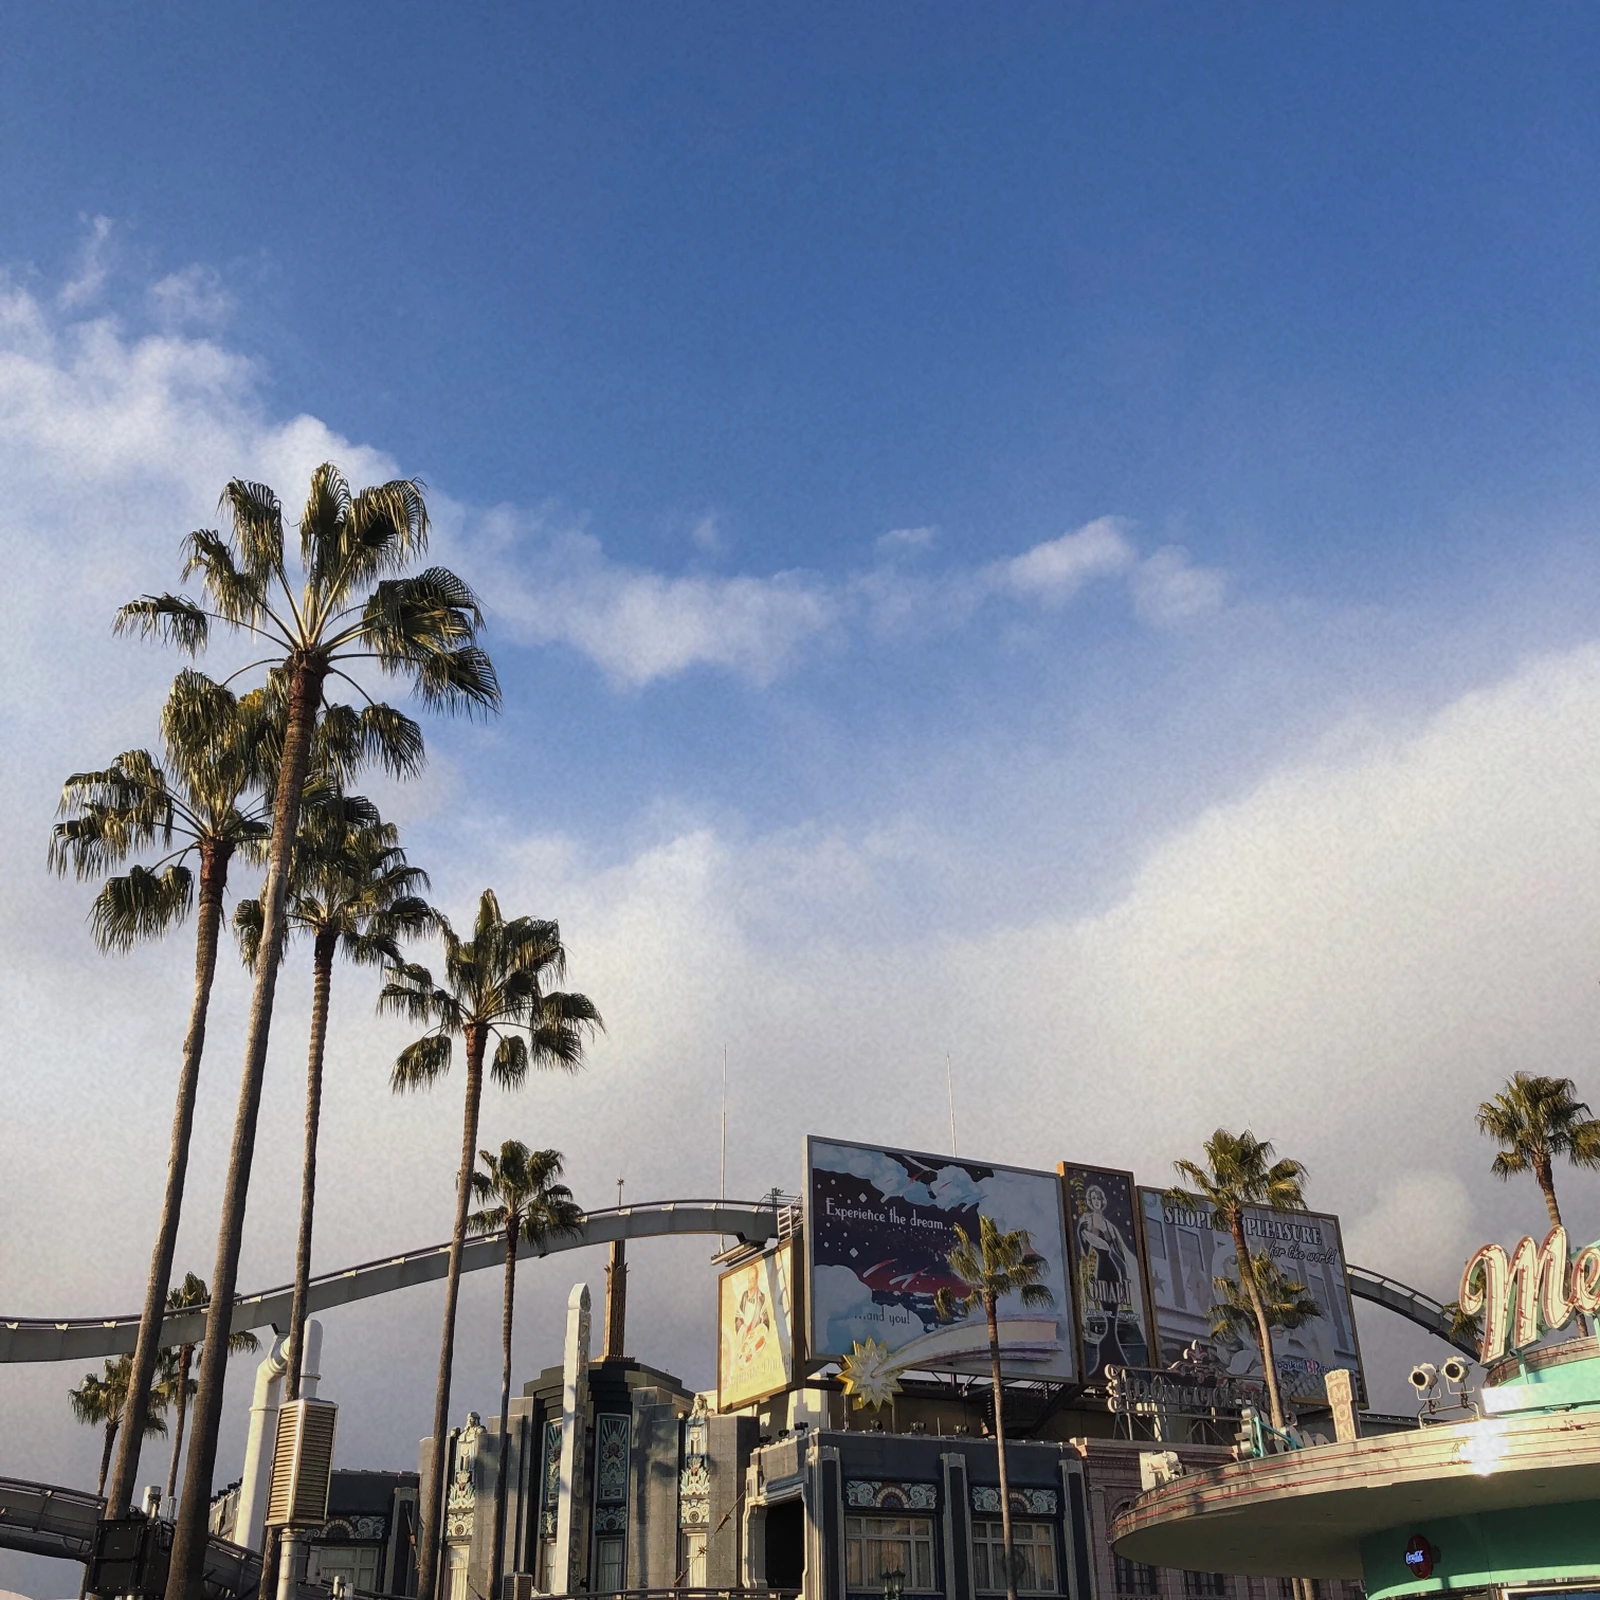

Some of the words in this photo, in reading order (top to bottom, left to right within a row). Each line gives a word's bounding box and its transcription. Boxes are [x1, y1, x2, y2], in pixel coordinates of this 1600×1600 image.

[826, 1197, 886, 1222] Experience
[889, 1206, 907, 1225] the
[1245, 1217, 1322, 1245] PLEASURE
[1269, 1240, 1286, 1261] for
[1287, 1243, 1305, 1261] the
[1306, 1246, 1338, 1265] world
[889, 1308, 911, 1327] you!
